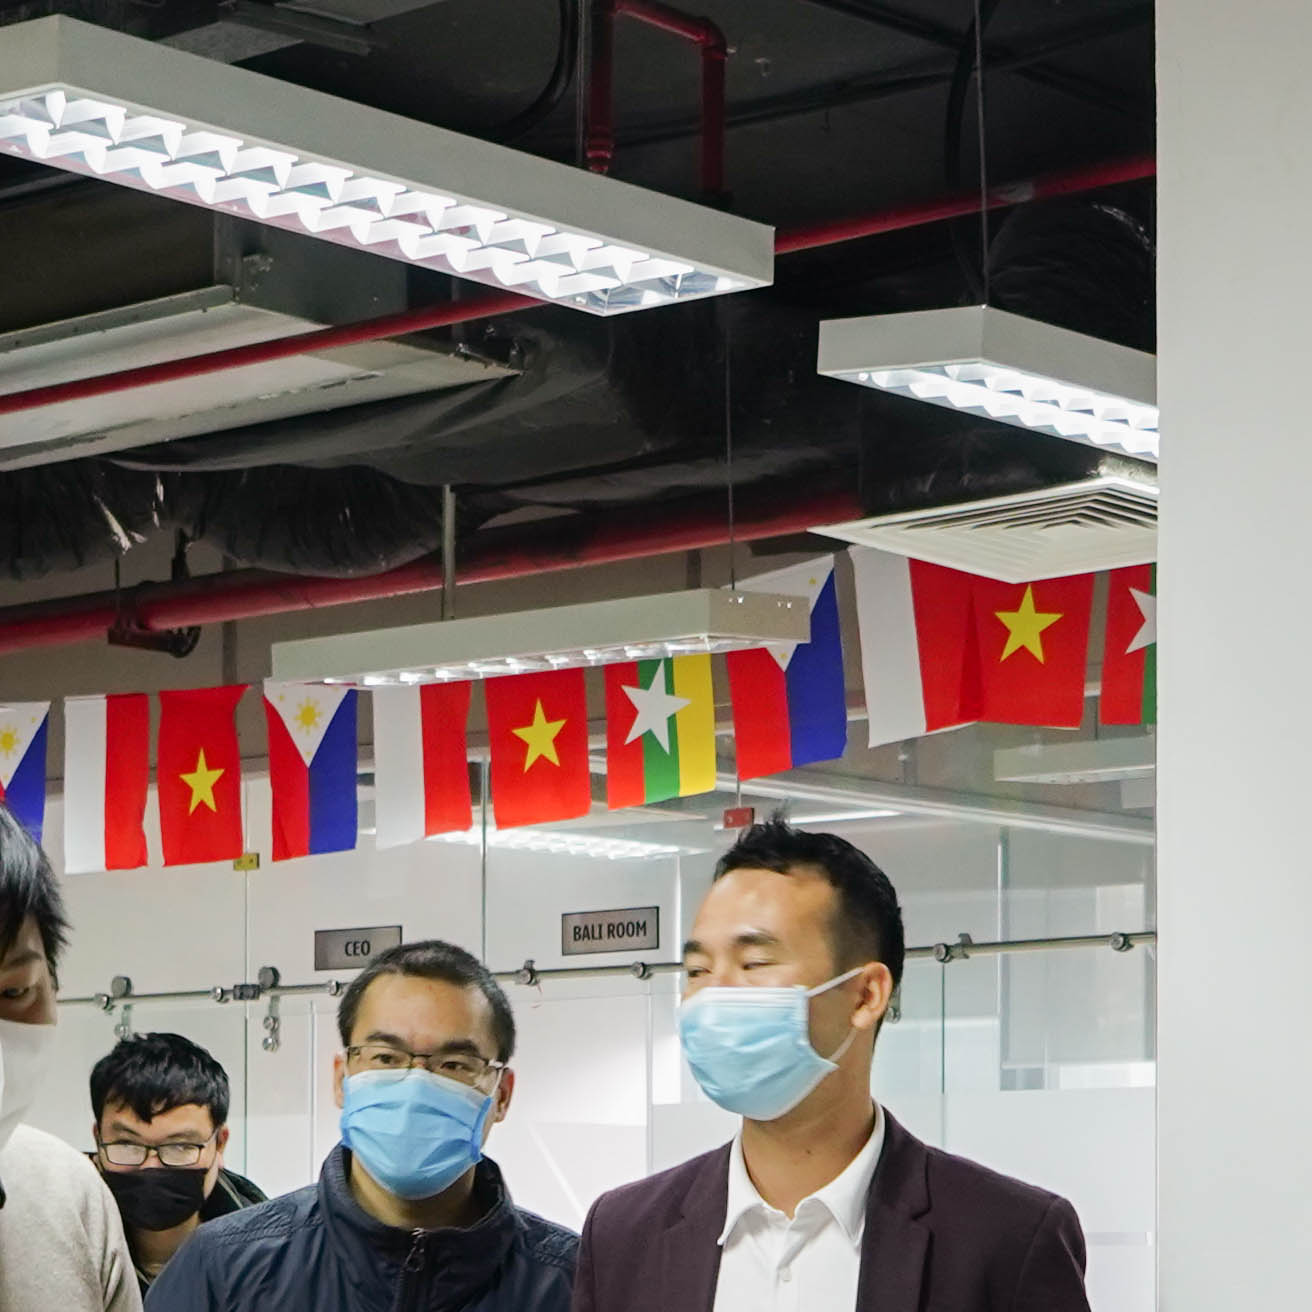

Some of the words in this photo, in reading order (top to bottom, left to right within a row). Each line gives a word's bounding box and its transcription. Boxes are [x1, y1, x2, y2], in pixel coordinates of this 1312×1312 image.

[573, 923, 603, 941] BALI
[607, 920, 647, 939] ROOM
[345, 940, 370, 956] CEO
